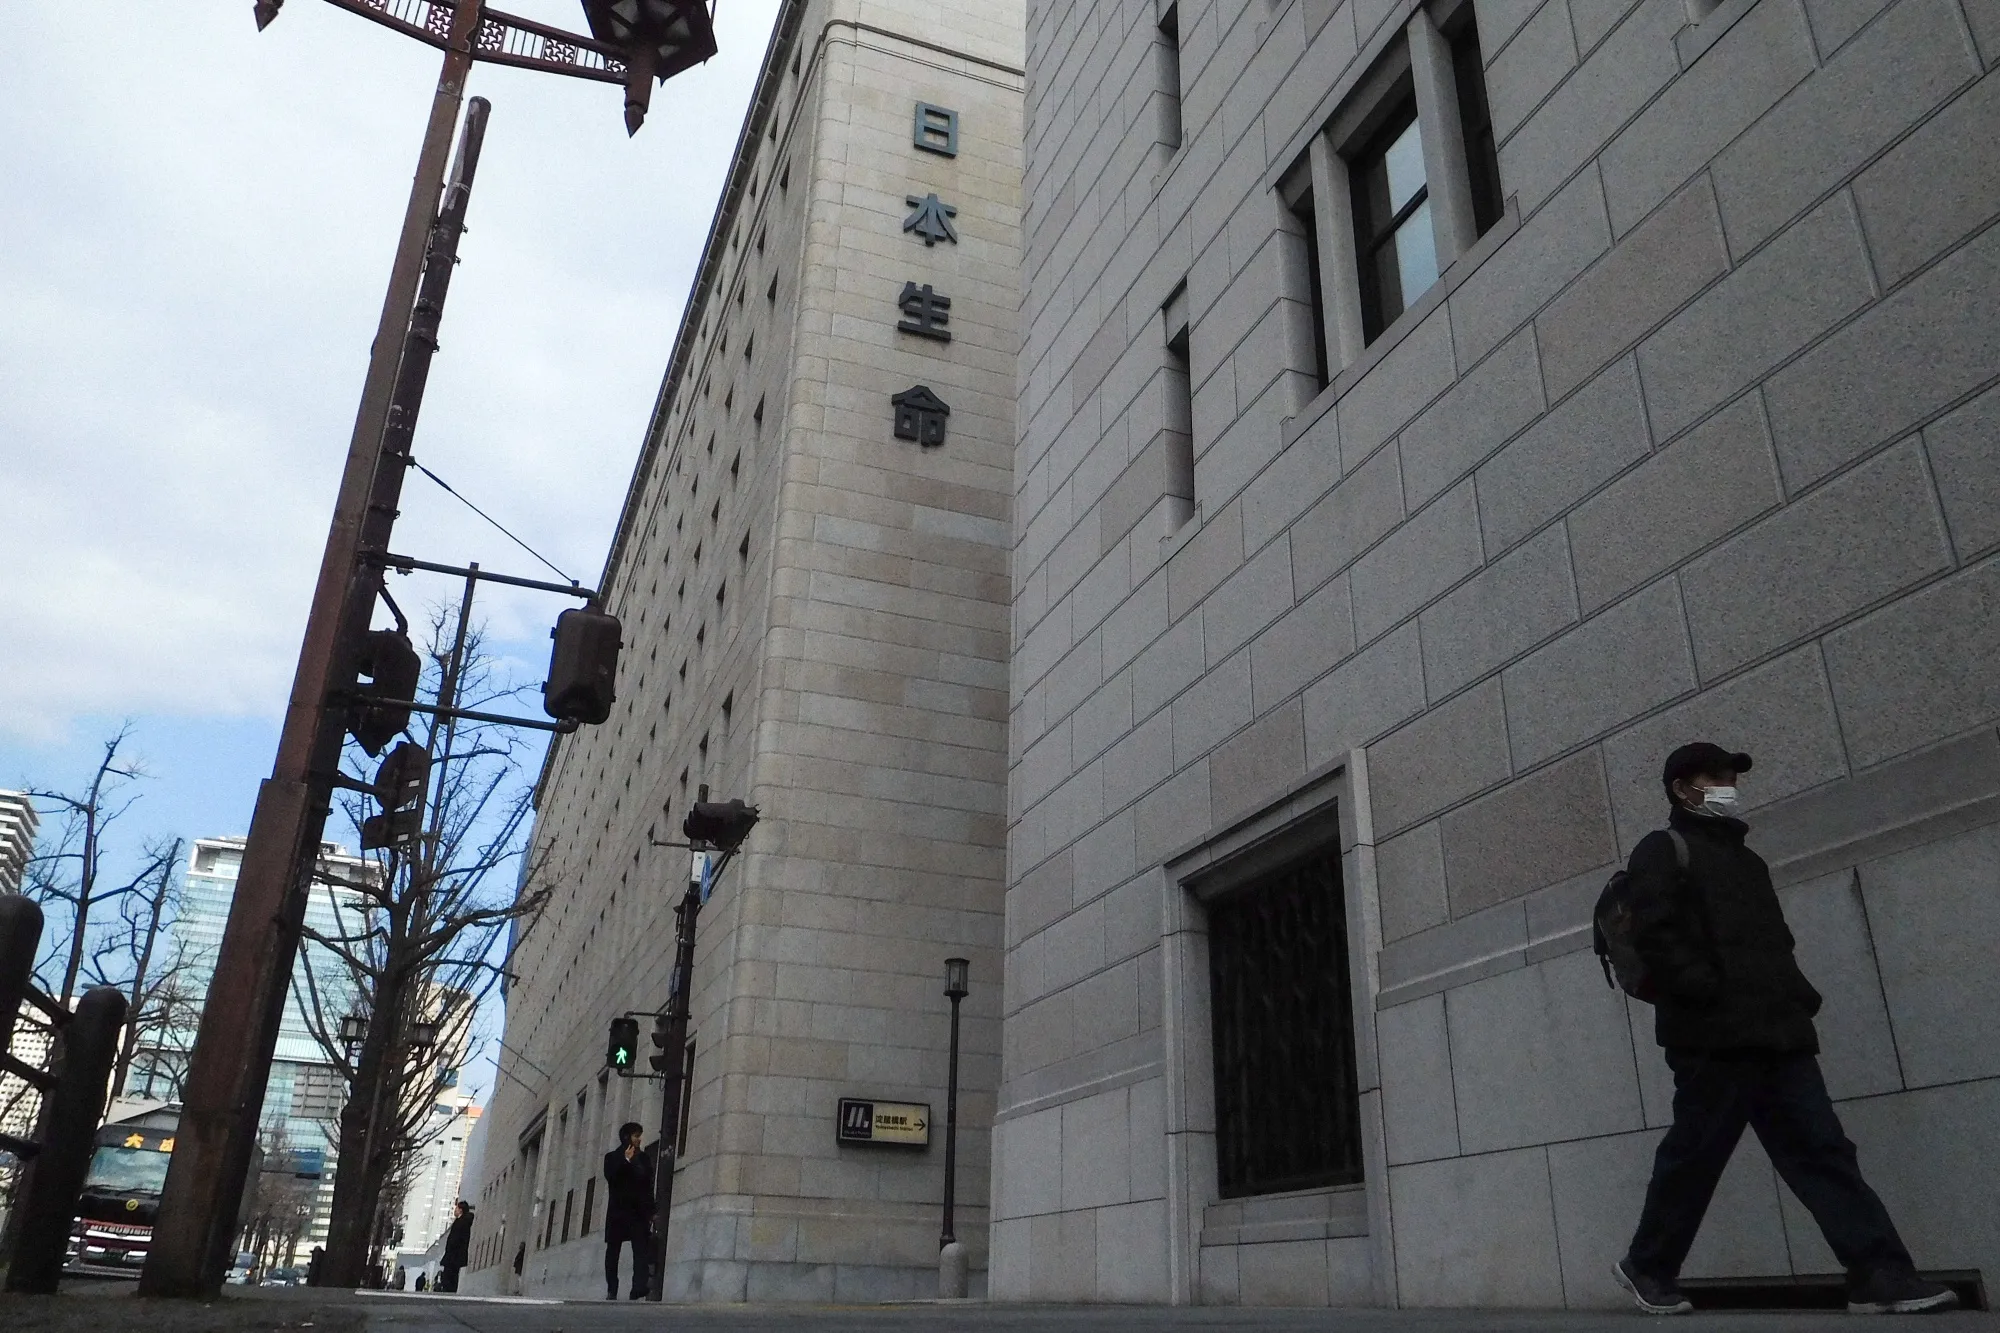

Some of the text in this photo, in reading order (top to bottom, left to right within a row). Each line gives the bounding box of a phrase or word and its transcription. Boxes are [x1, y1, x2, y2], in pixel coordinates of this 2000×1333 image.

[891, 101, 959, 447] 日本生命
[90, 1224, 153, 1236] MITSUBISHI
